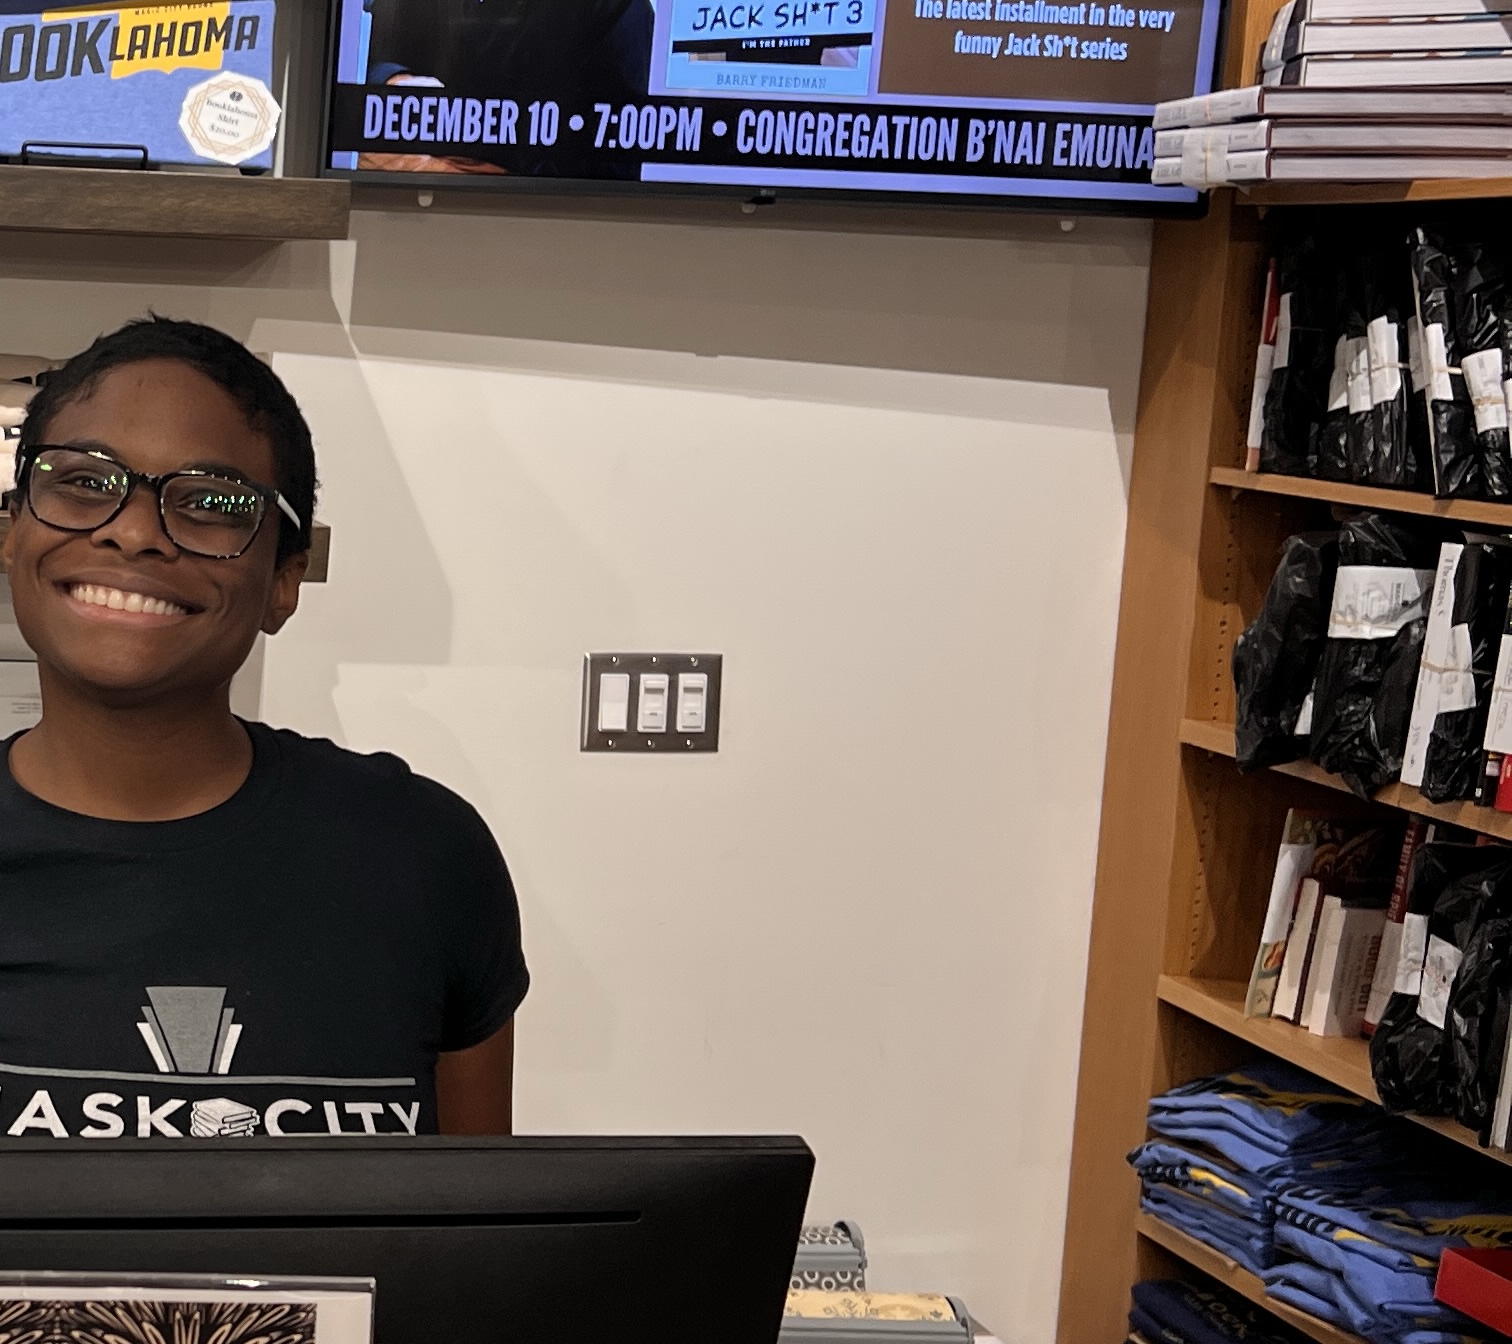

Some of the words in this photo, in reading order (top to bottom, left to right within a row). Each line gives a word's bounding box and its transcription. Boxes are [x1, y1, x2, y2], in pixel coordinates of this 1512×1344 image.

[1088, 3, 1104, 26] in
[1108, 4, 1136, 28] the
[1139, 9, 1176, 33] very
[954, 29, 1002, 58] funny
[1004, 32, 1040, 57] Jack
[1080, 37, 1128, 61] series
[716, 73, 757, 87] BARRY
[761, 75, 826, 89] FRIEDMAN
[363, 94, 519, 145] DECEMBER
[528, 101, 560, 147] 10
[594, 103, 703, 152] 7:00PM
[736, 108, 959, 163] CONGREGATION
[1053, 123, 1154, 170] EMUNA
[265, 1098, 420, 1137] CITY
